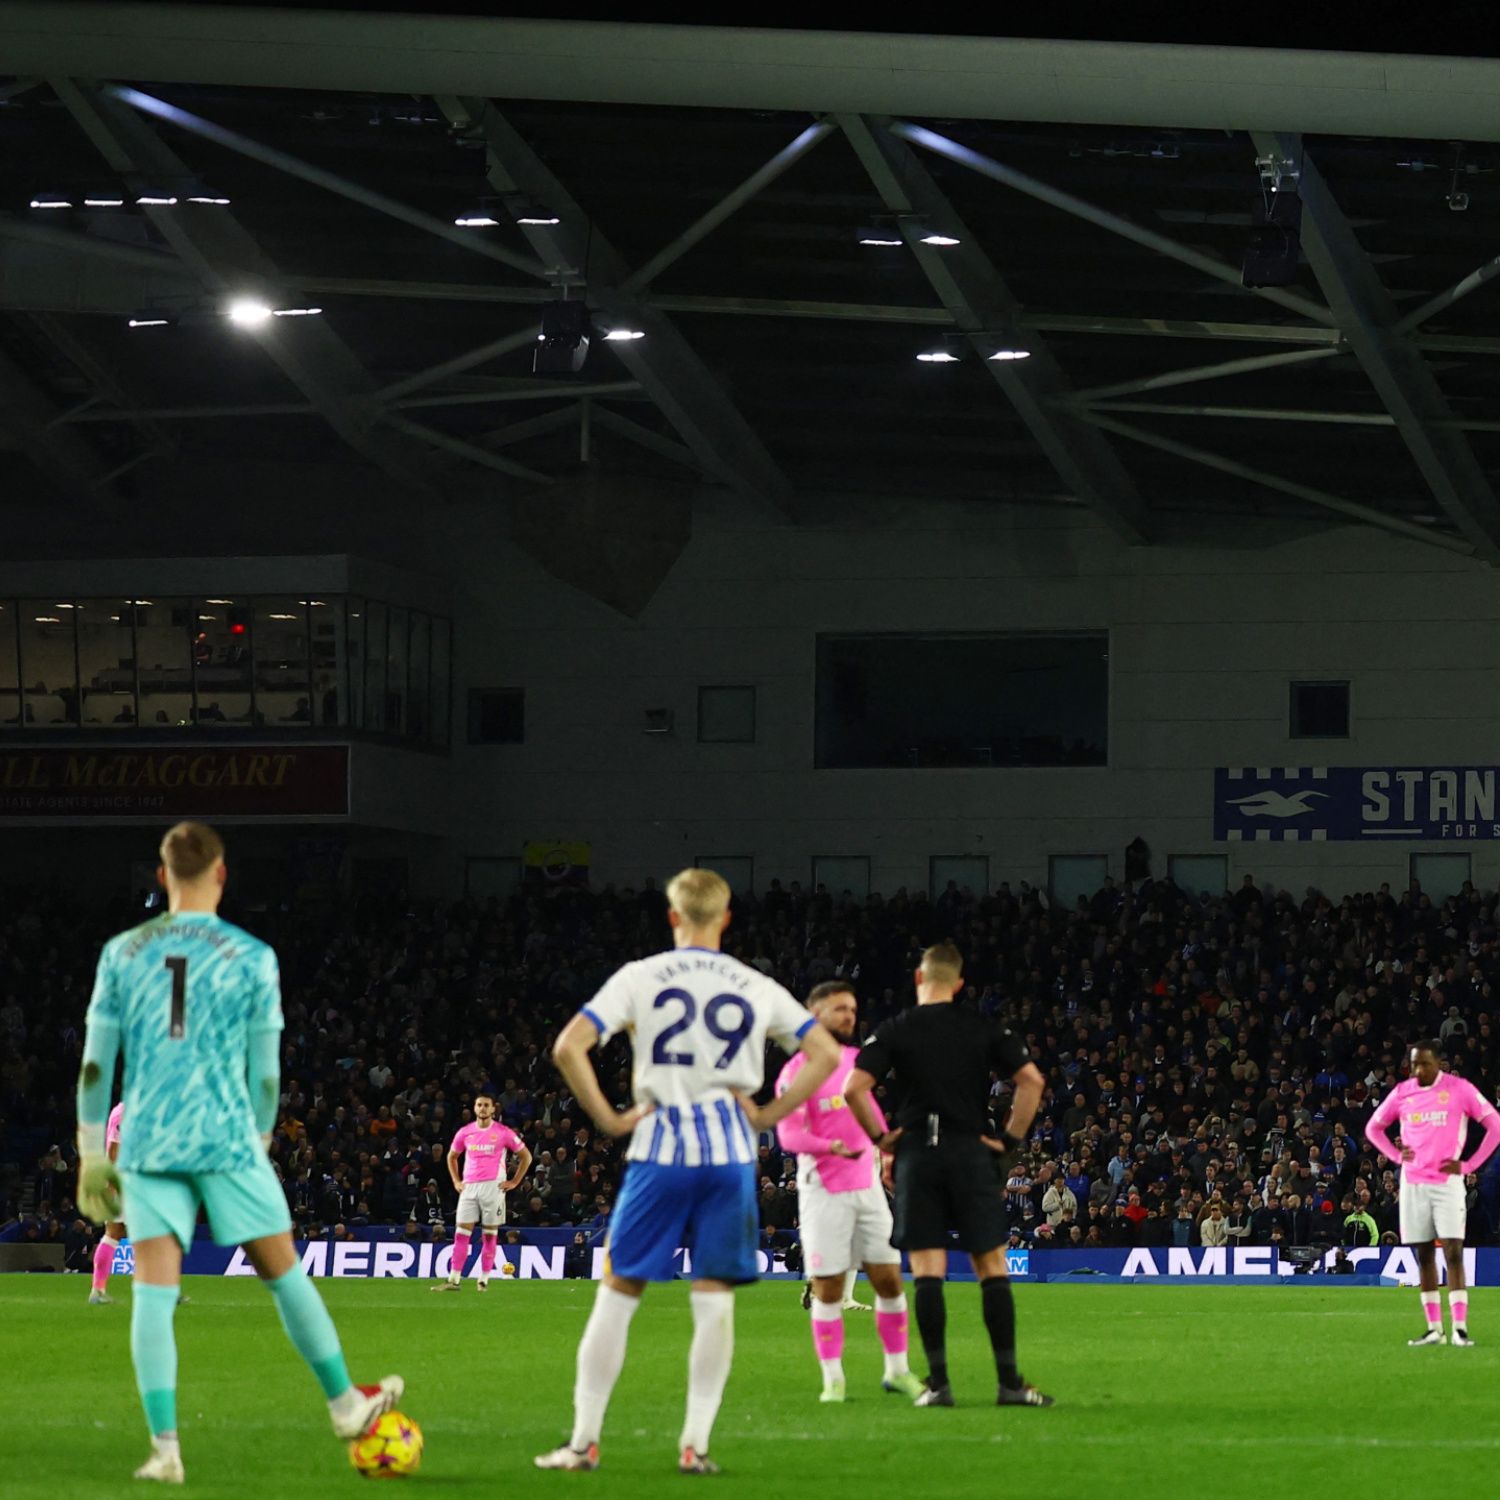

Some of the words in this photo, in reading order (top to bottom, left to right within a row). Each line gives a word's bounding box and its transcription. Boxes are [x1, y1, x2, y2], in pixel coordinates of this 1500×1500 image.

[63, 753, 298, 787] McTAGGART
[1442, 824, 1477, 837] FOR
[165, 955, 188, 1039] 1
[653, 987, 756, 1070] 29
